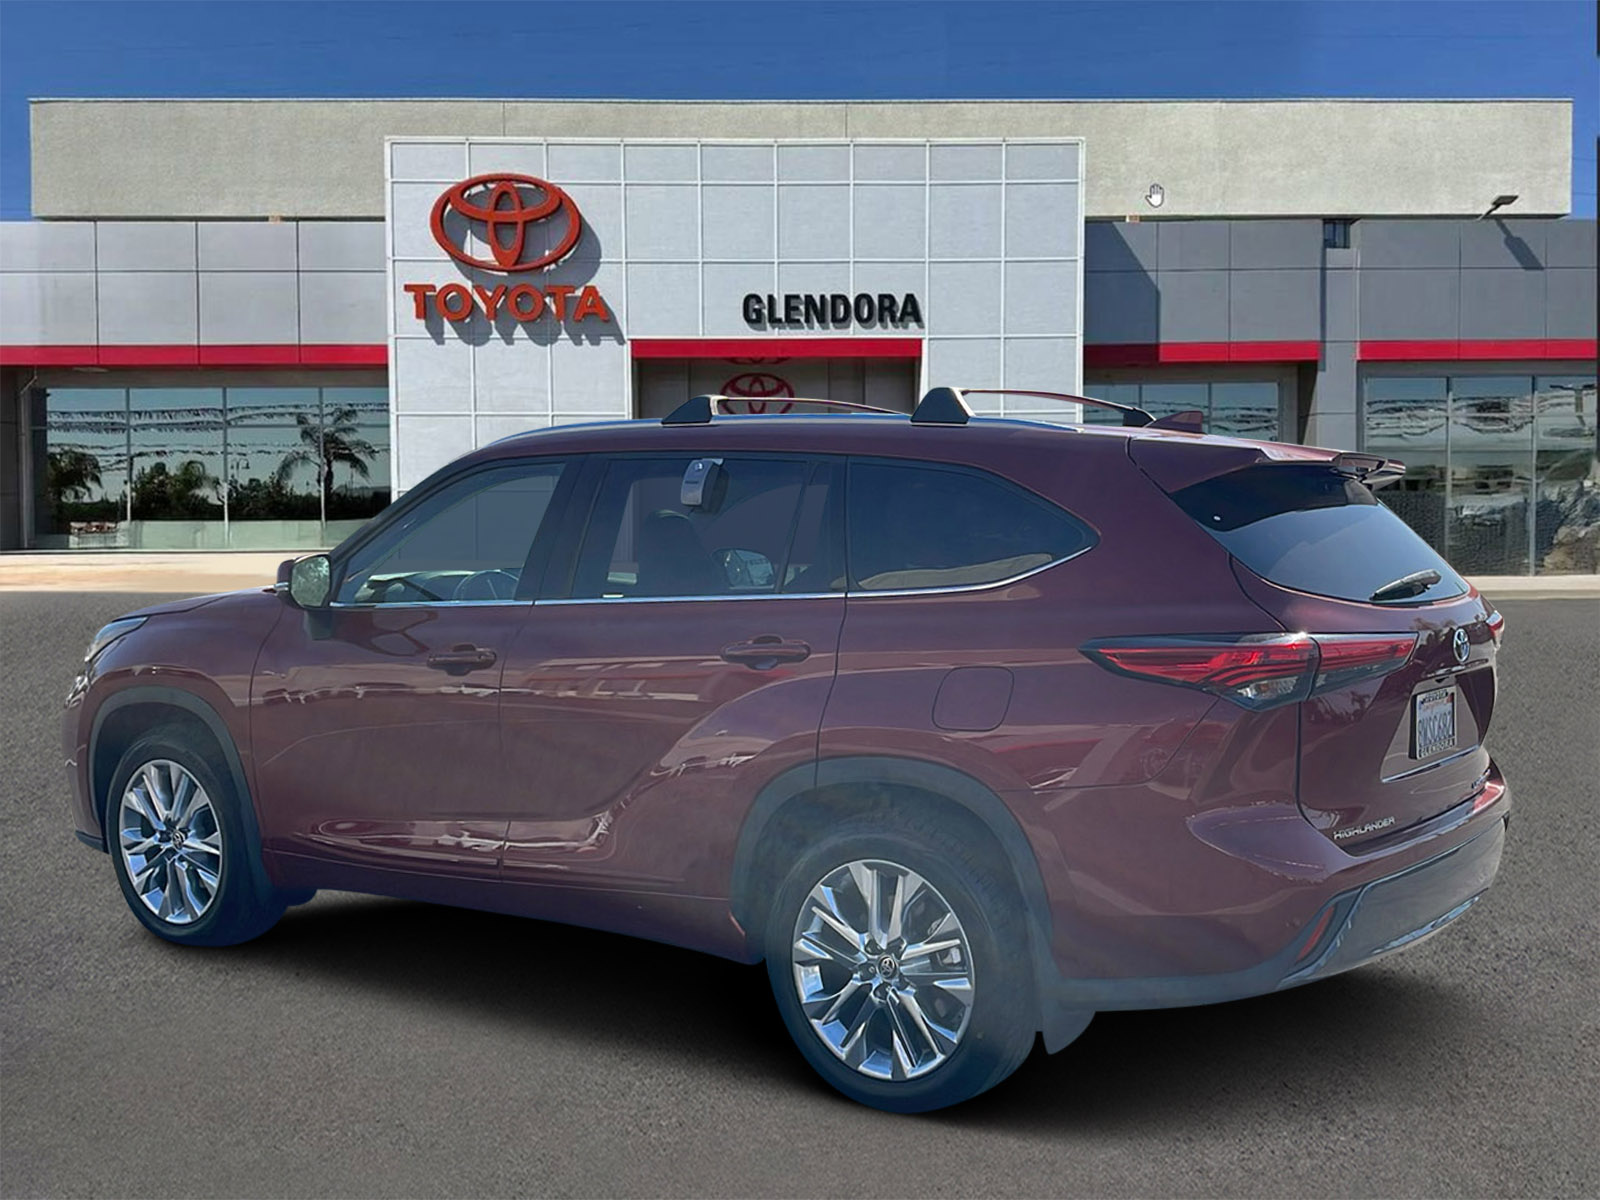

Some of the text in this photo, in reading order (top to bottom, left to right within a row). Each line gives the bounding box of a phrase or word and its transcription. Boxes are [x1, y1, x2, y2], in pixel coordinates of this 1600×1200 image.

[404, 284, 609, 322] TOYOTA
[742, 293, 922, 324] GLENDORA
[1333, 816, 1395, 839] HIGHLANDER
